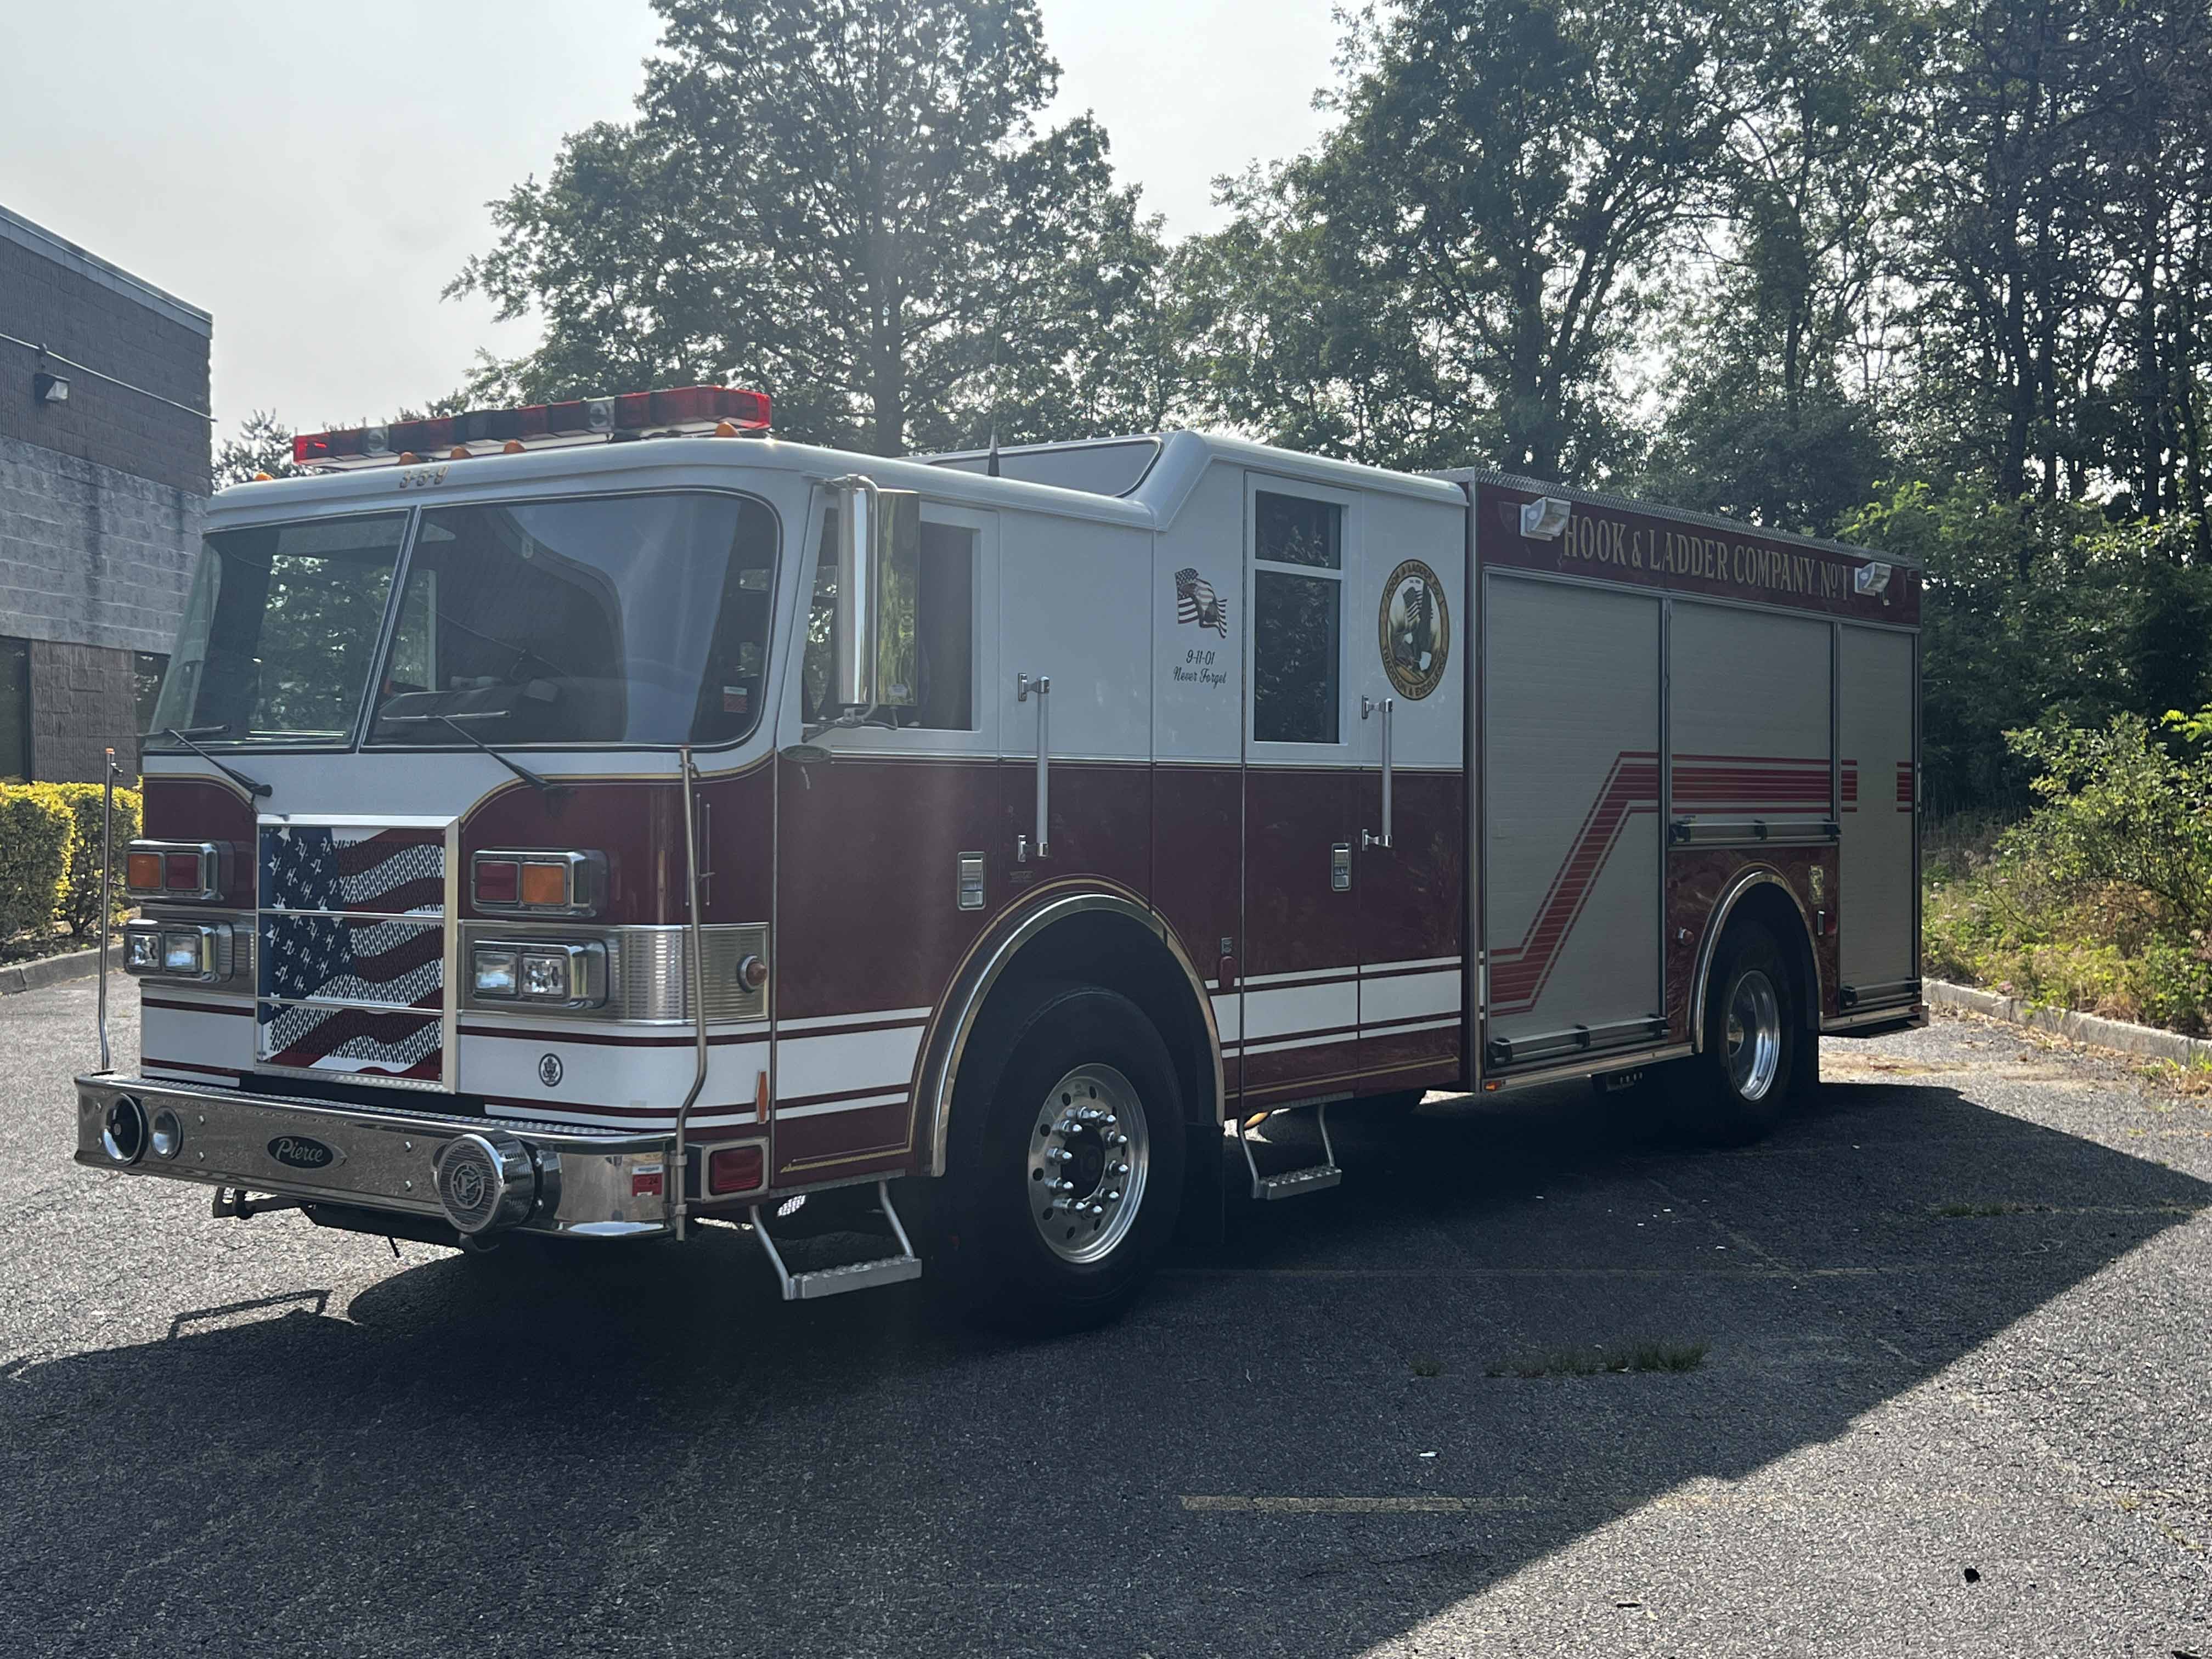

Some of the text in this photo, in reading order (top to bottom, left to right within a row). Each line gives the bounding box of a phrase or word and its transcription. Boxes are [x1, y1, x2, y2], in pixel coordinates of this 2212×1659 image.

[399, 465, 451, 489] 3-5-9
[1564, 514, 1627, 566] HOOK
[1632, 531, 1643, 568] &
[1648, 529, 1729, 581] LADDER
[1733, 544, 1815, 595] COMPANY
[1186, 649, 1216, 665] 9-11-01
[1173, 666, 1227, 690] Never Forget
[276, 1137, 325, 1163] Pierce
